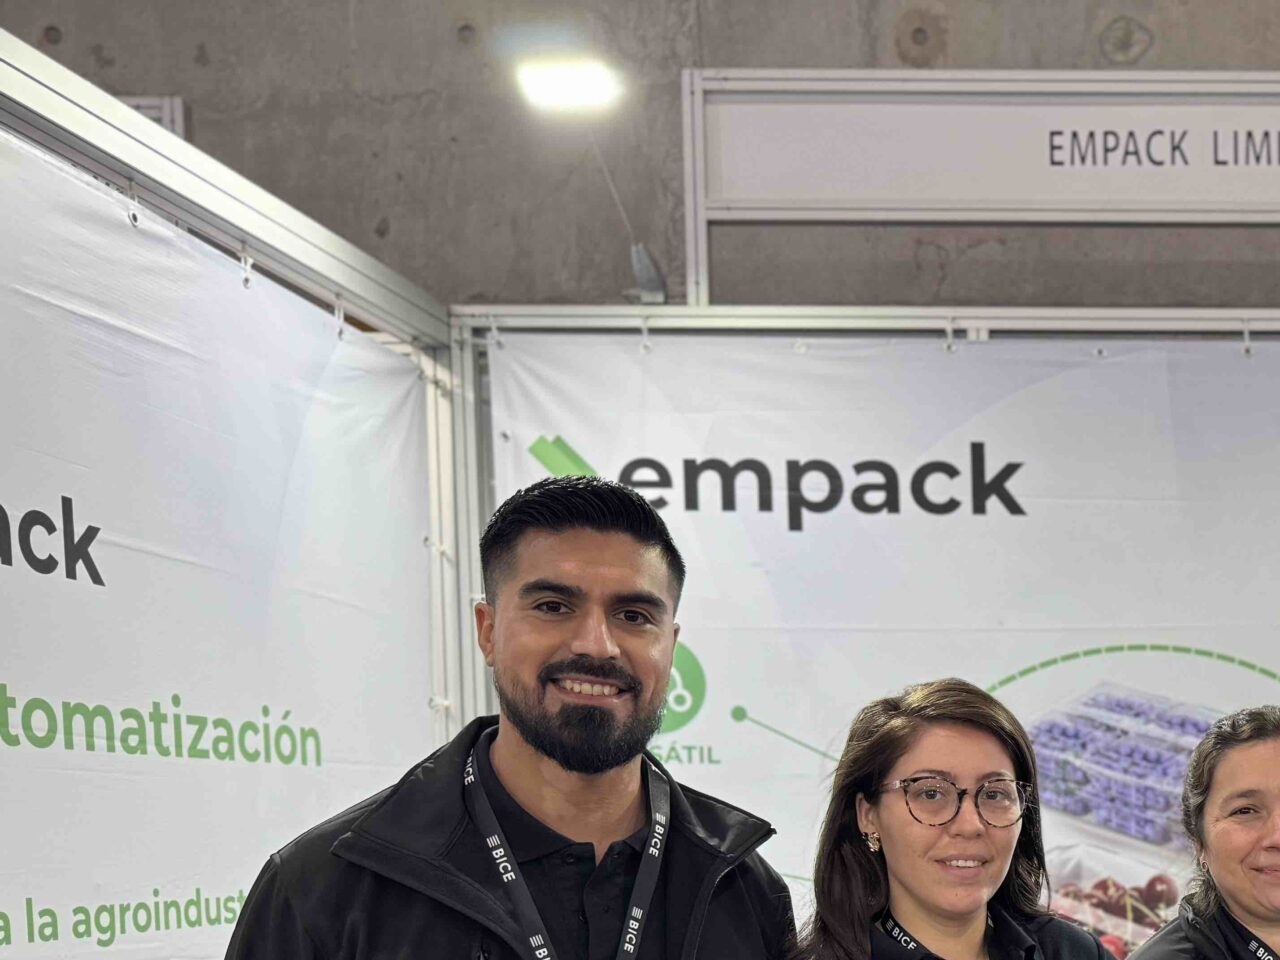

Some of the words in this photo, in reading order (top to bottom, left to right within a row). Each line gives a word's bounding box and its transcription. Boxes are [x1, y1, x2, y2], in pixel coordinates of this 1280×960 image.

[1048, 131, 1189, 169] EMPACK
[619, 442, 1027, 531] empack
[0, 683, 322, 767] tomatización
[649, 824, 666, 857] BICE
[492, 848, 516, 883] BICE
[25, 898, 58, 943] la
[624, 918, 641, 954] BICE
[892, 926, 917, 950] BICE
